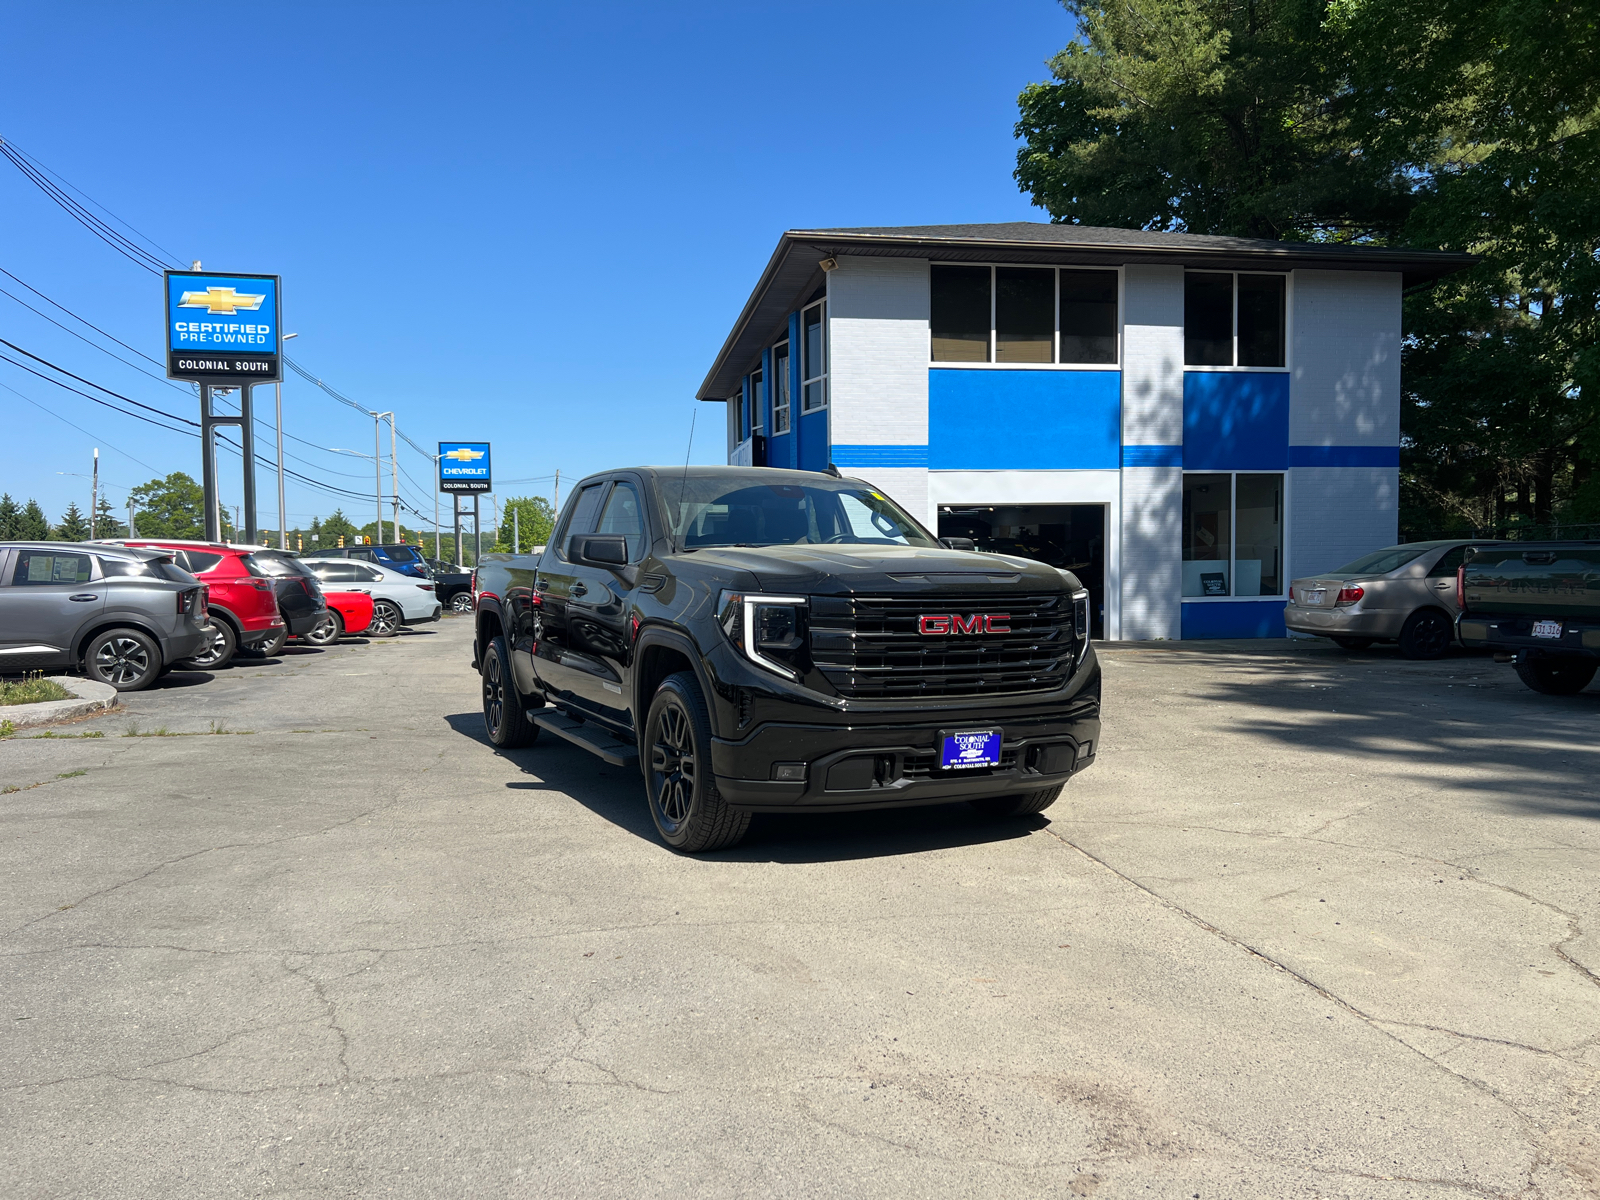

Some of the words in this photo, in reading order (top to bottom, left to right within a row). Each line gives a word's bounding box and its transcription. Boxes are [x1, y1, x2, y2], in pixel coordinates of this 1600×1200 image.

[175, 322, 270, 334] CERTIFIED
[180, 332, 266, 344] PRE-OWNED
[179, 359, 230, 370] COLONIAL
[235, 361, 269, 371] SOUTH
[918, 613, 1012, 635] GMC
[954, 735, 990, 744] COLONIAL
[959, 742, 985, 750] SOUTH
